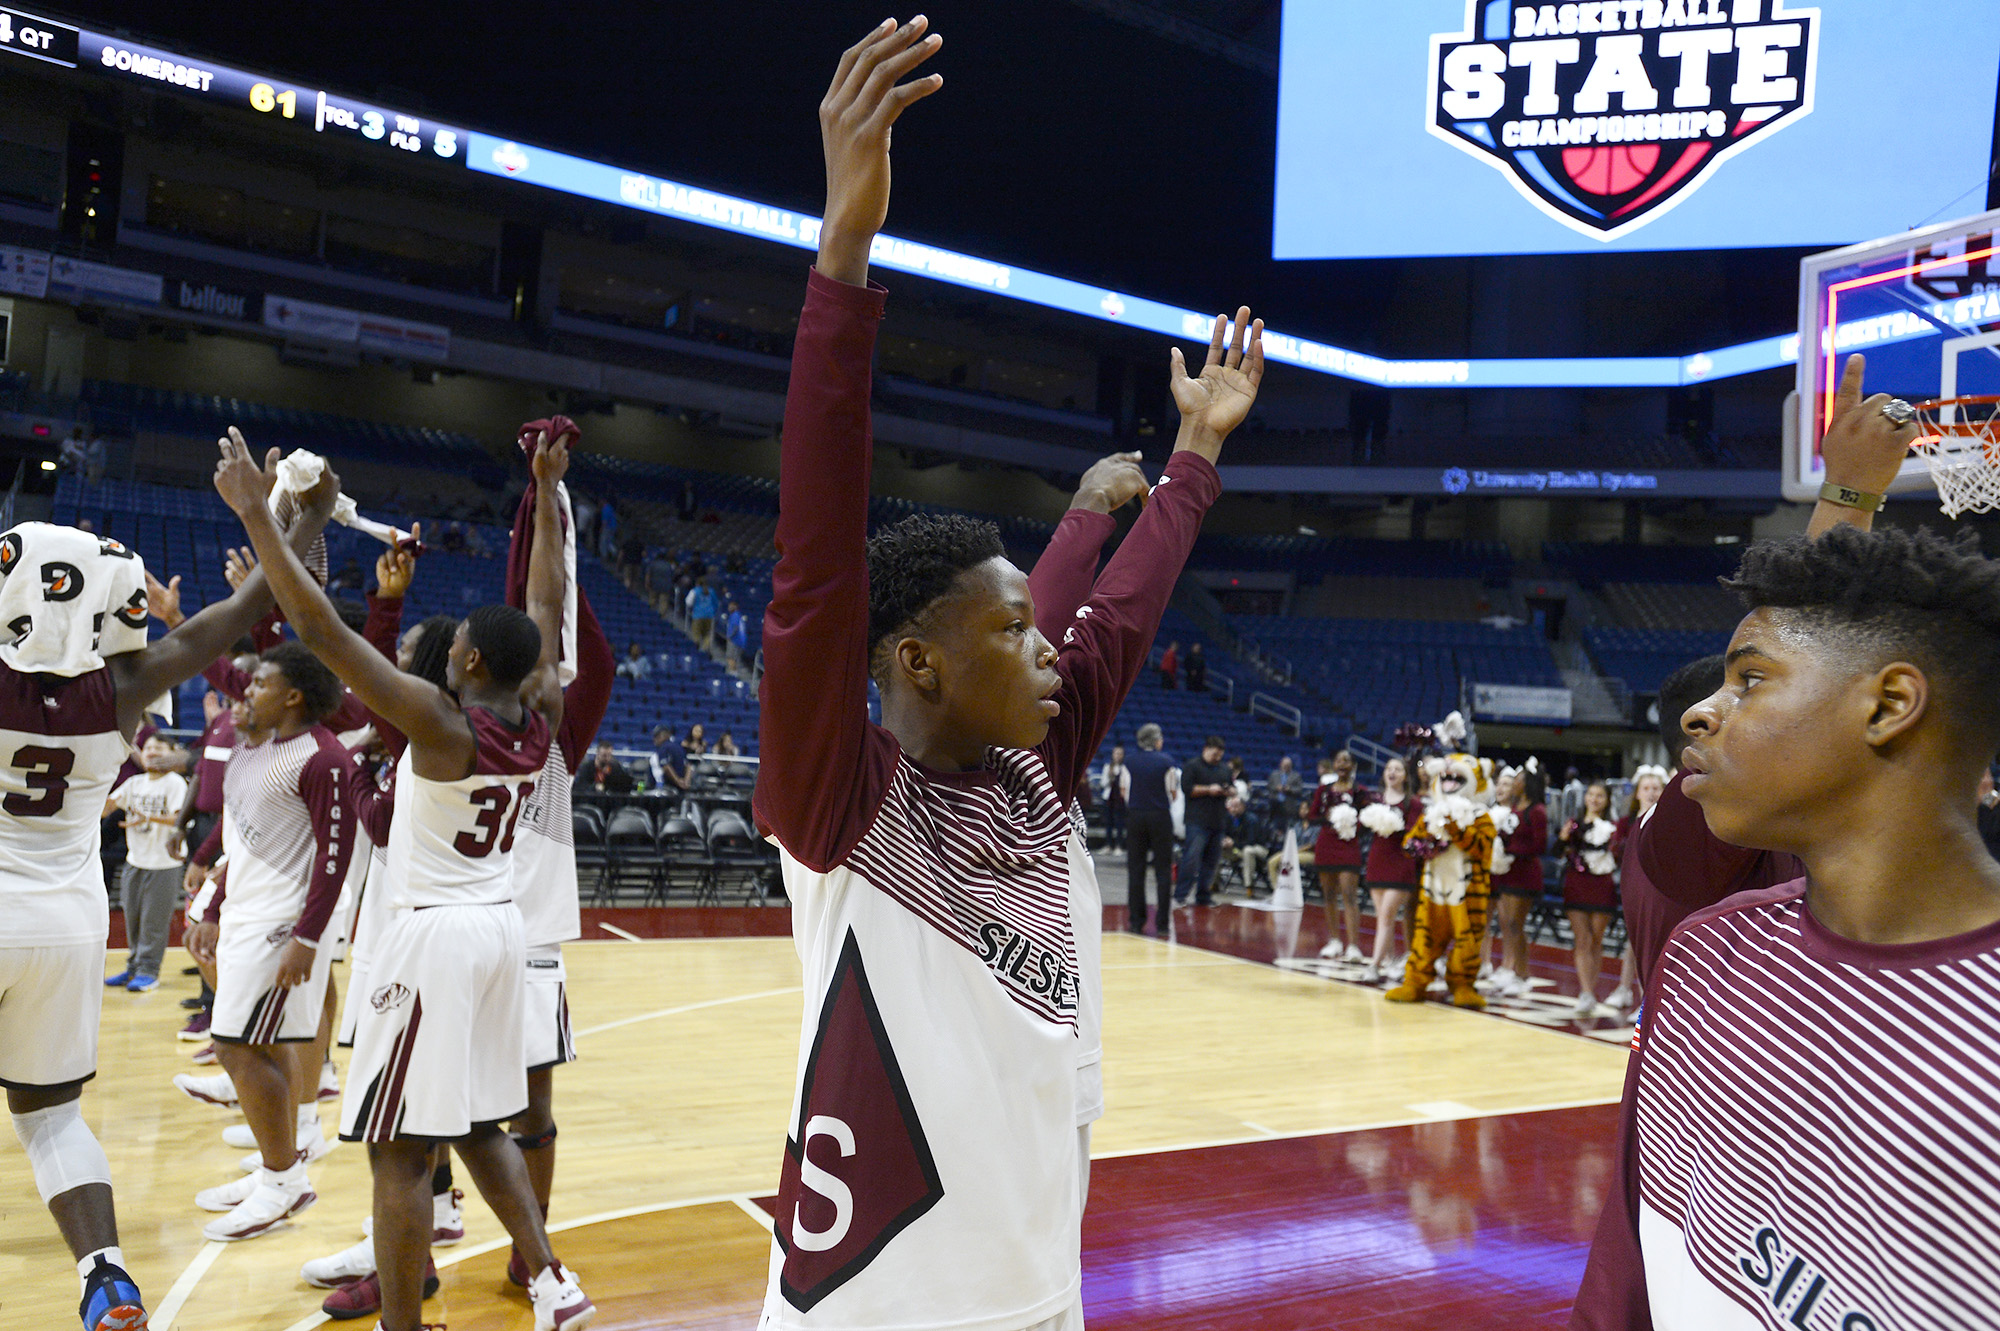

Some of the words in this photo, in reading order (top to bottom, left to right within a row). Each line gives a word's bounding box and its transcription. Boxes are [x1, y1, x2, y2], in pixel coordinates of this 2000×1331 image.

[19, 27, 54, 50] QT
[1513, 0, 1728, 38] BASKETBALL
[101, 46, 214, 92] SOMERSET
[250, 83, 297, 119] 61
[1442, 23, 1802, 120] STATE
[361, 111, 386, 140] 3
[390, 131, 421, 152] FLS
[433, 129, 457, 158] 5
[1502, 110, 1727, 147] CHAMPIONSHIPS
[659, 182, 797, 239] BASKETBALL
[181, 281, 246, 318] balfour
[2, 745, 76, 817] 3
[325, 767, 342, 875] TIGERS
[792, 1115, 856, 1252] S
